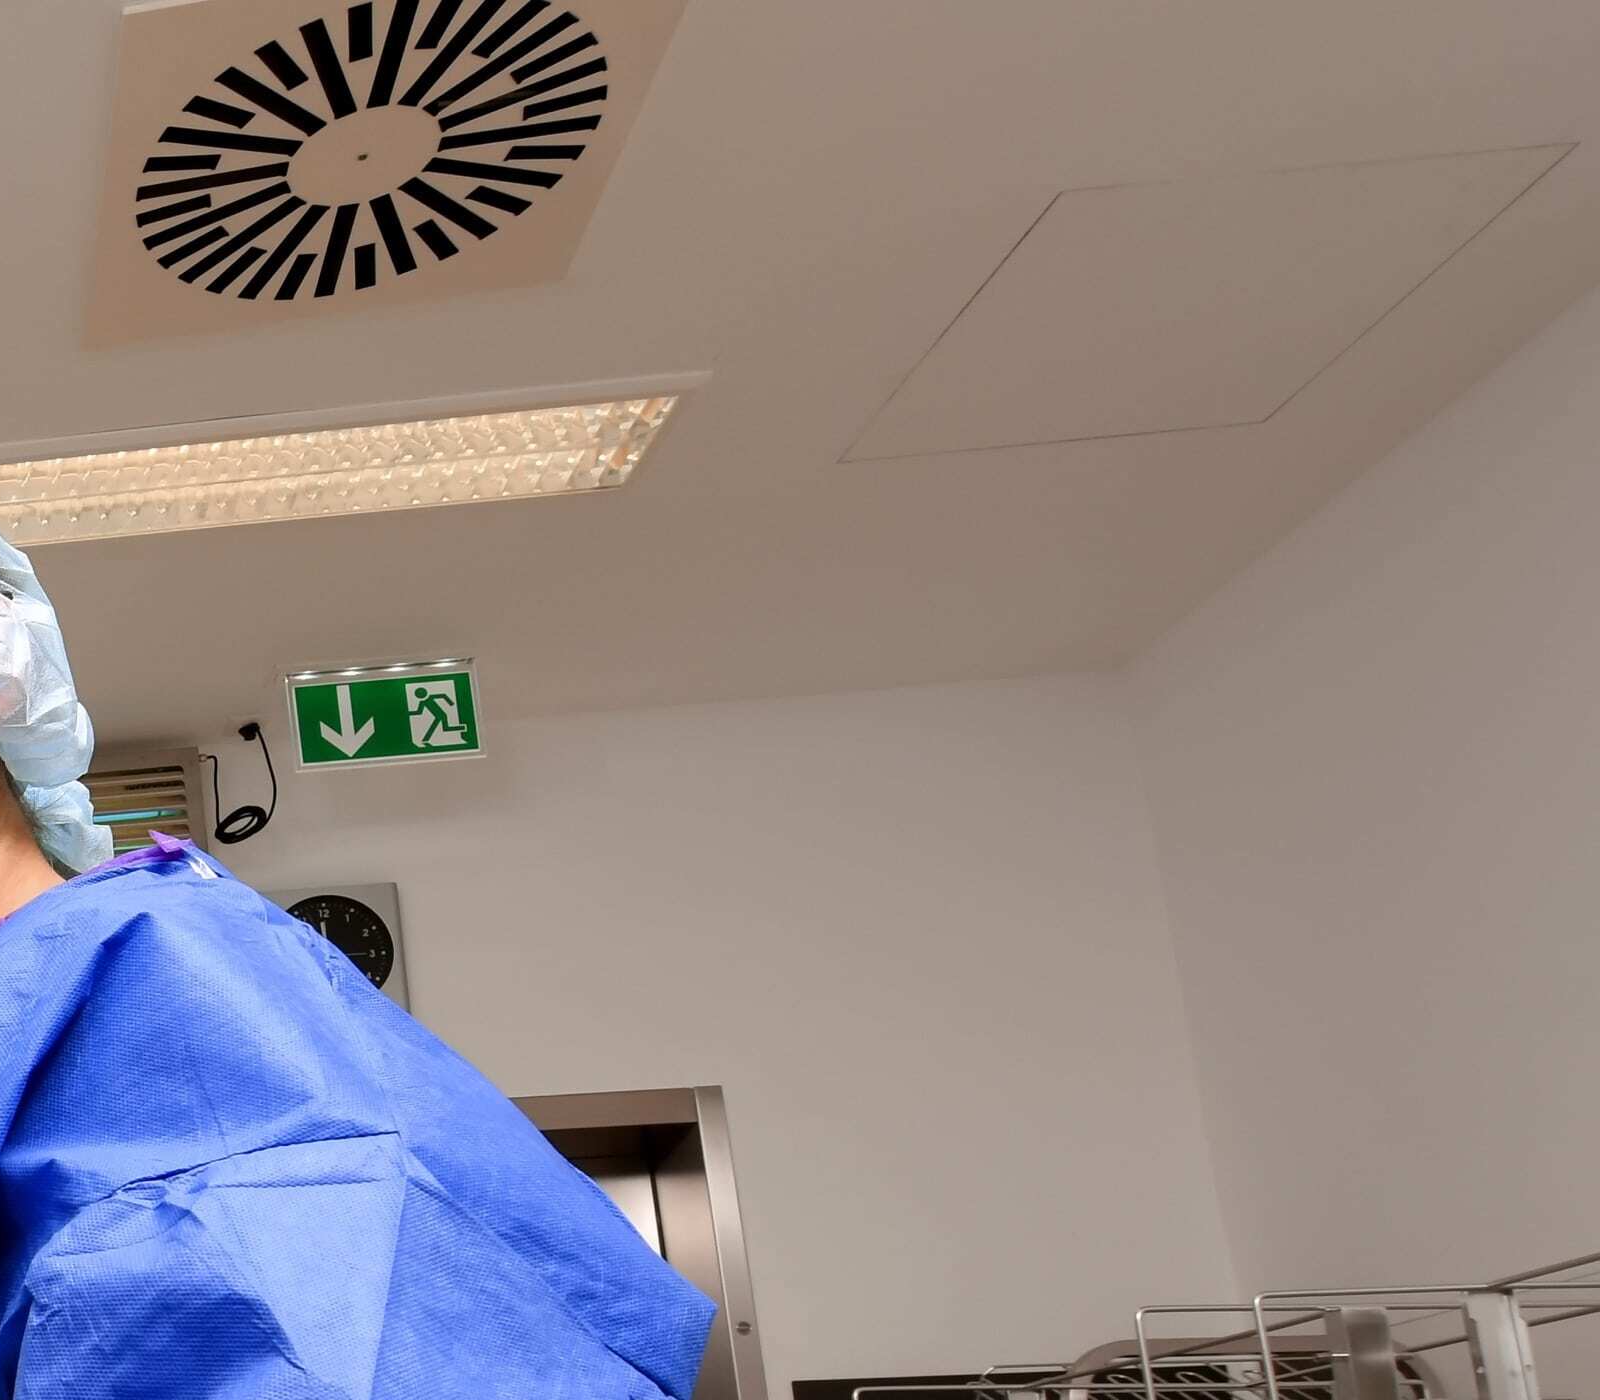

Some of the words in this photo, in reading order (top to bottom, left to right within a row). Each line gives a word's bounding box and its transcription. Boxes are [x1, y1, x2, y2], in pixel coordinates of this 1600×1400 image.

[320, 909, 329, 918] 12
[362, 929, 369, 937] 2
[369, 949, 376, 958] 3
